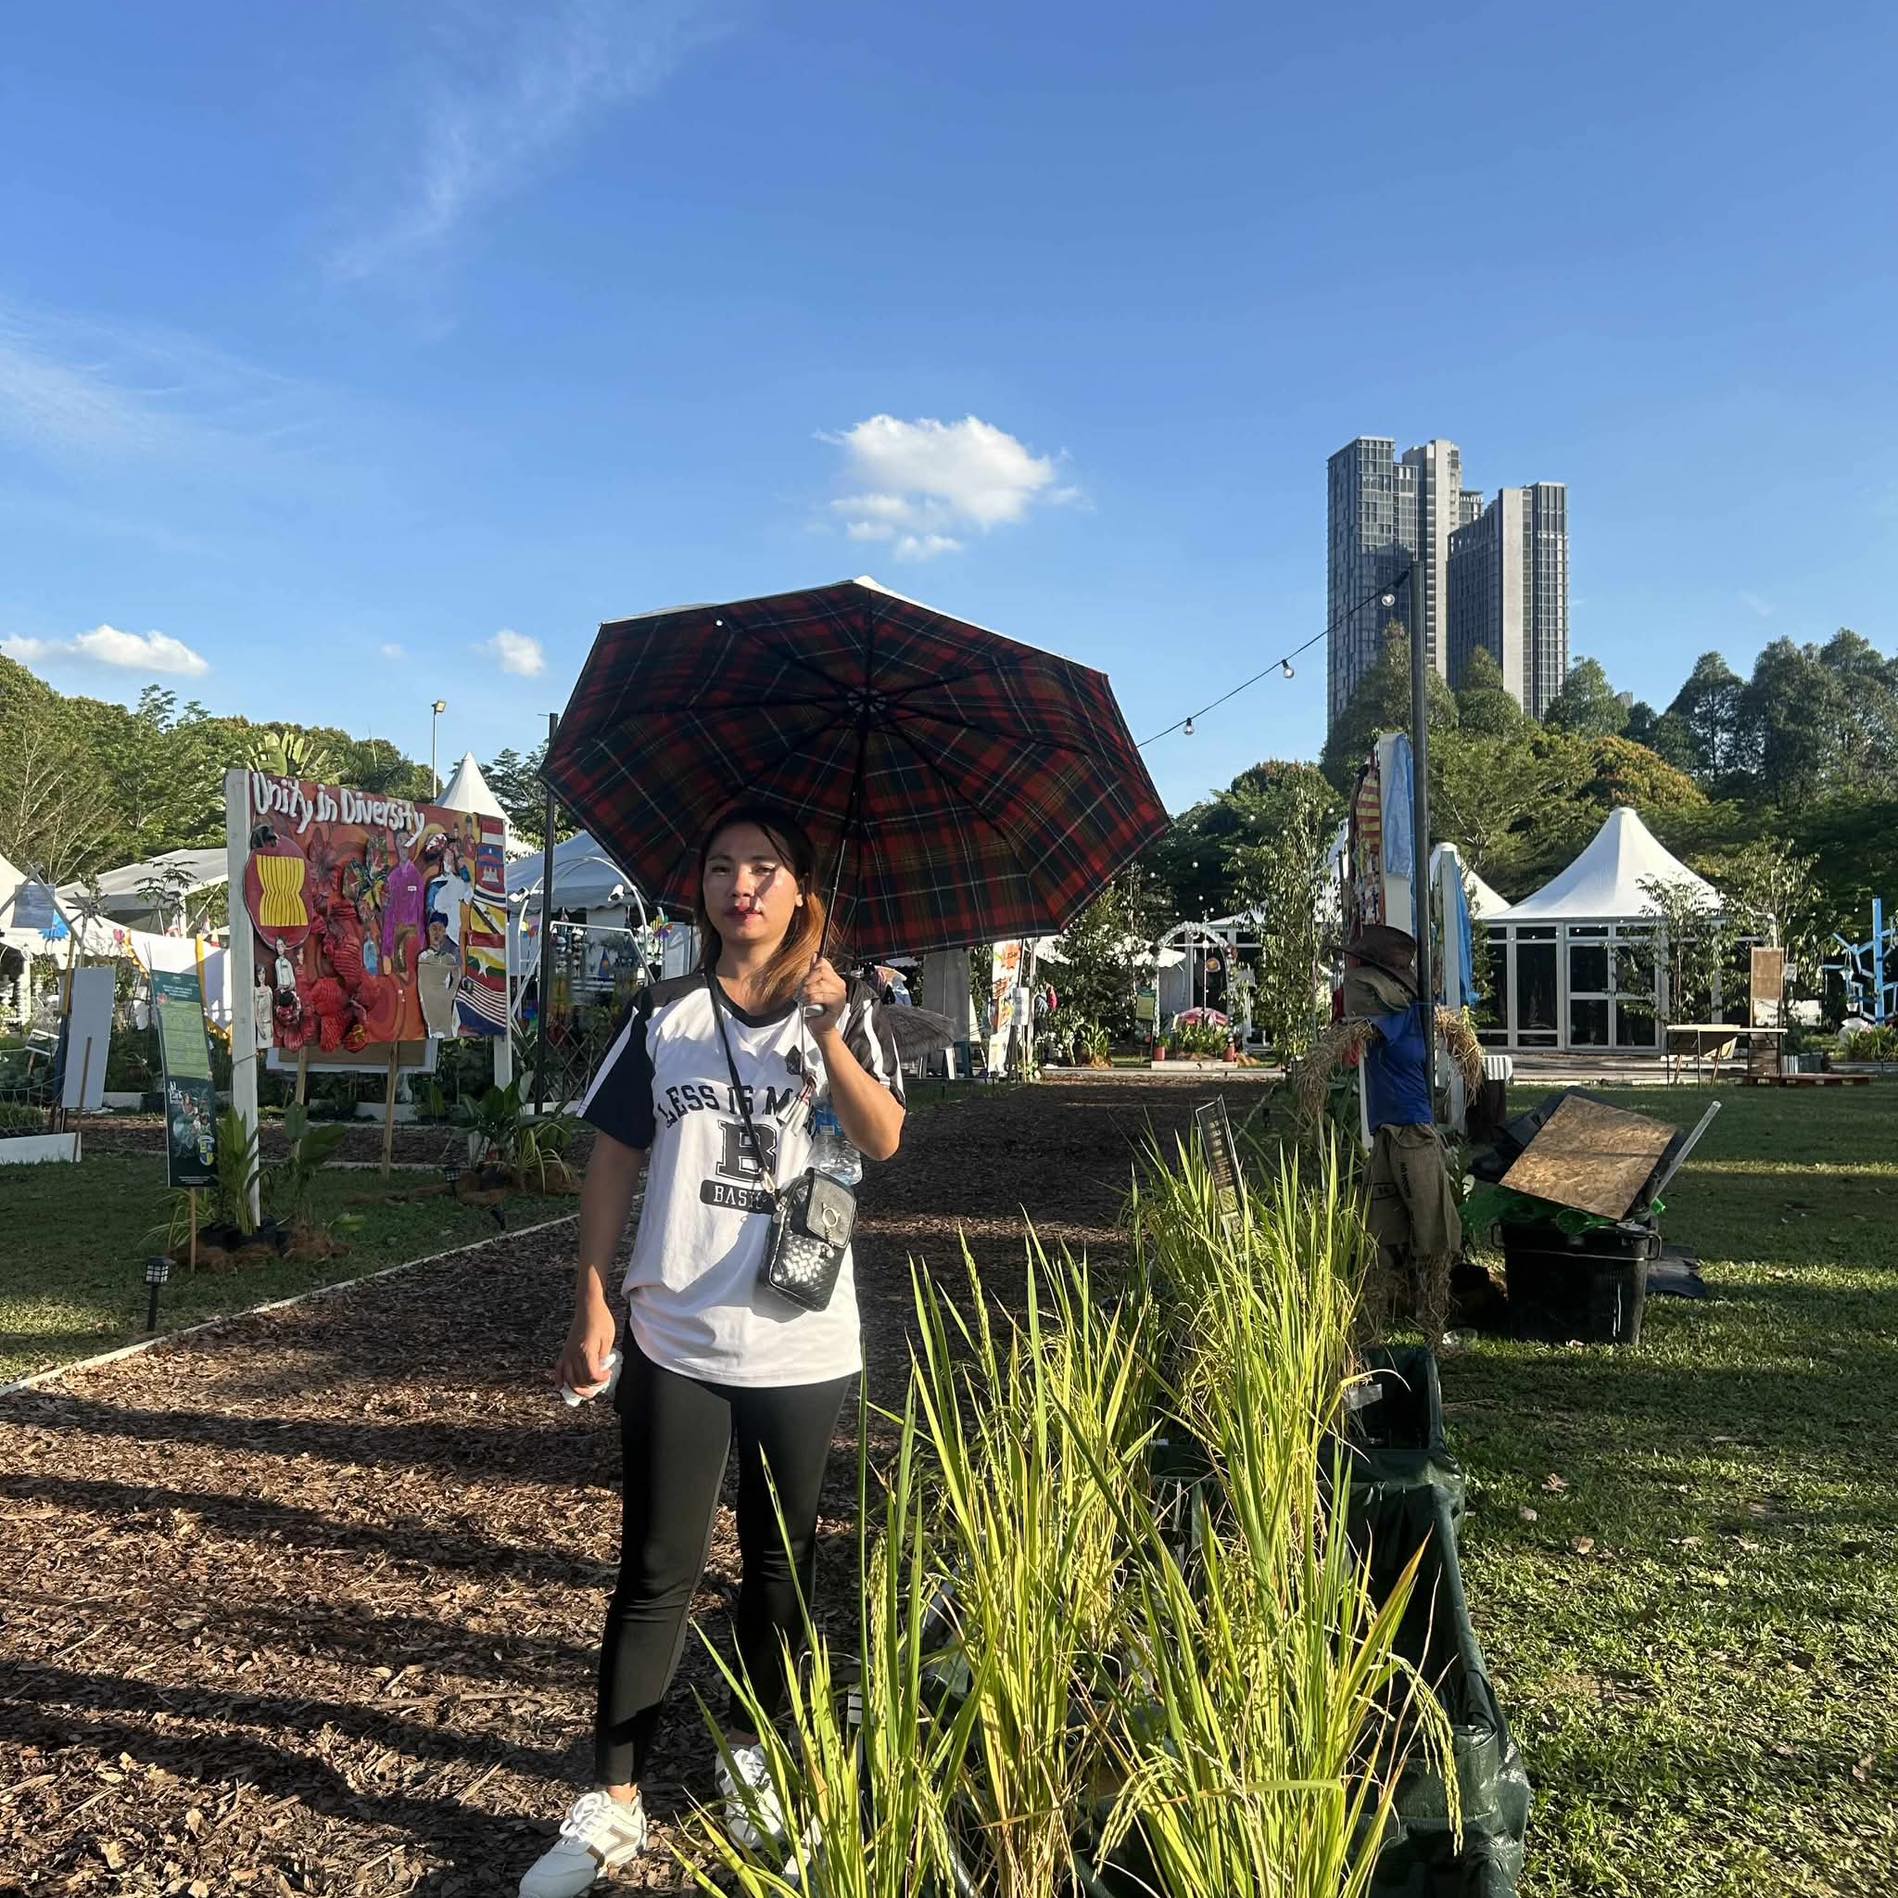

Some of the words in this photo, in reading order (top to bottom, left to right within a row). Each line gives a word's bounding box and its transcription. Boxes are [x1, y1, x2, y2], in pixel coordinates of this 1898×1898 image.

[252, 772, 314, 833] Unity
[315, 784, 338, 822] in
[339, 788, 425, 847] Diversity
[658, 1085, 720, 1128] LESS
[728, 1085, 754, 1115] IS
[717, 1120, 777, 1183] B
